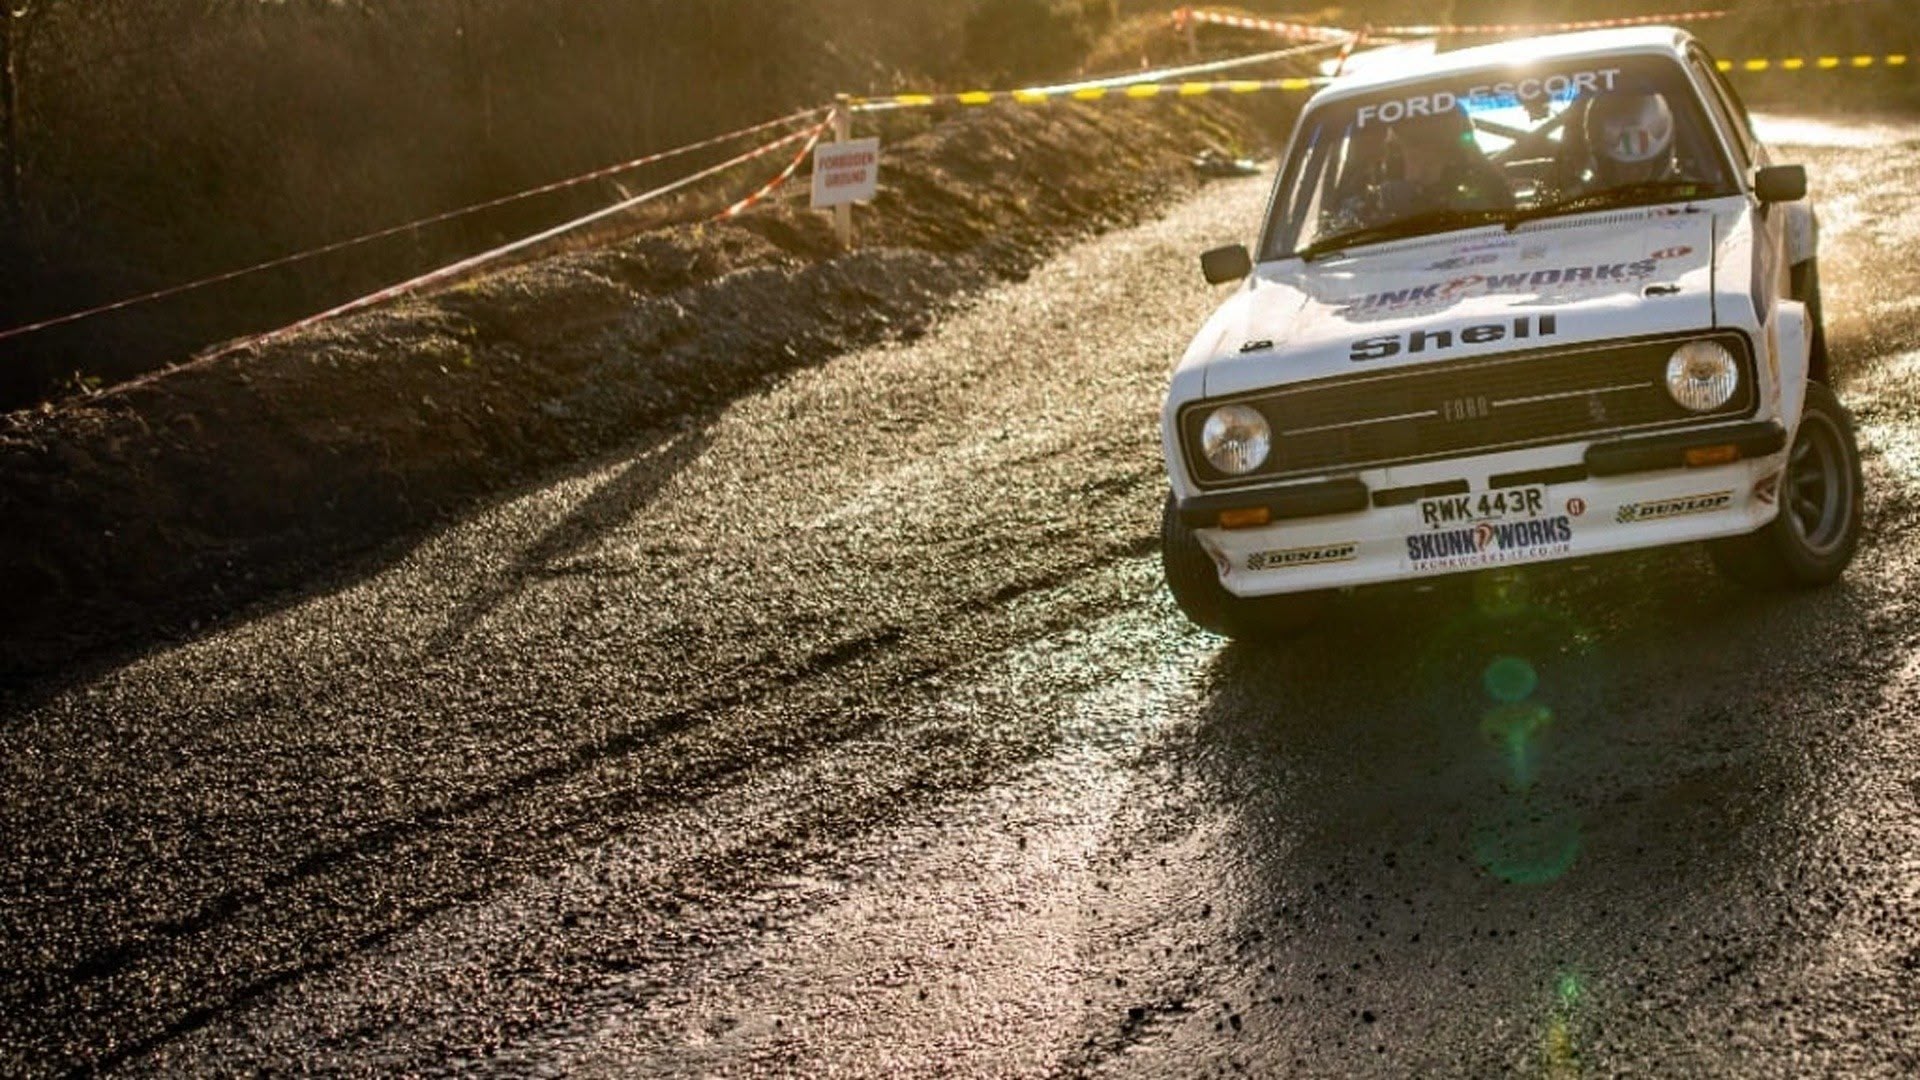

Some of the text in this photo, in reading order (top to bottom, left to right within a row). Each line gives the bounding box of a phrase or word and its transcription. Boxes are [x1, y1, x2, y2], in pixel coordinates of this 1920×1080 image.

[1357, 69, 1620, 128] FORD ESCORT
[1487, 259, 1657, 289] WORKS
[1350, 314, 1556, 361] Shell
[1422, 497, 1473, 524] RWK
[1477, 488, 1543, 516] 443R
[1639, 496, 1730, 516] DUNLOP
[1268, 546, 1354, 563] DUNLOP
[1406, 516, 1572, 561] SKUNK WORKS
